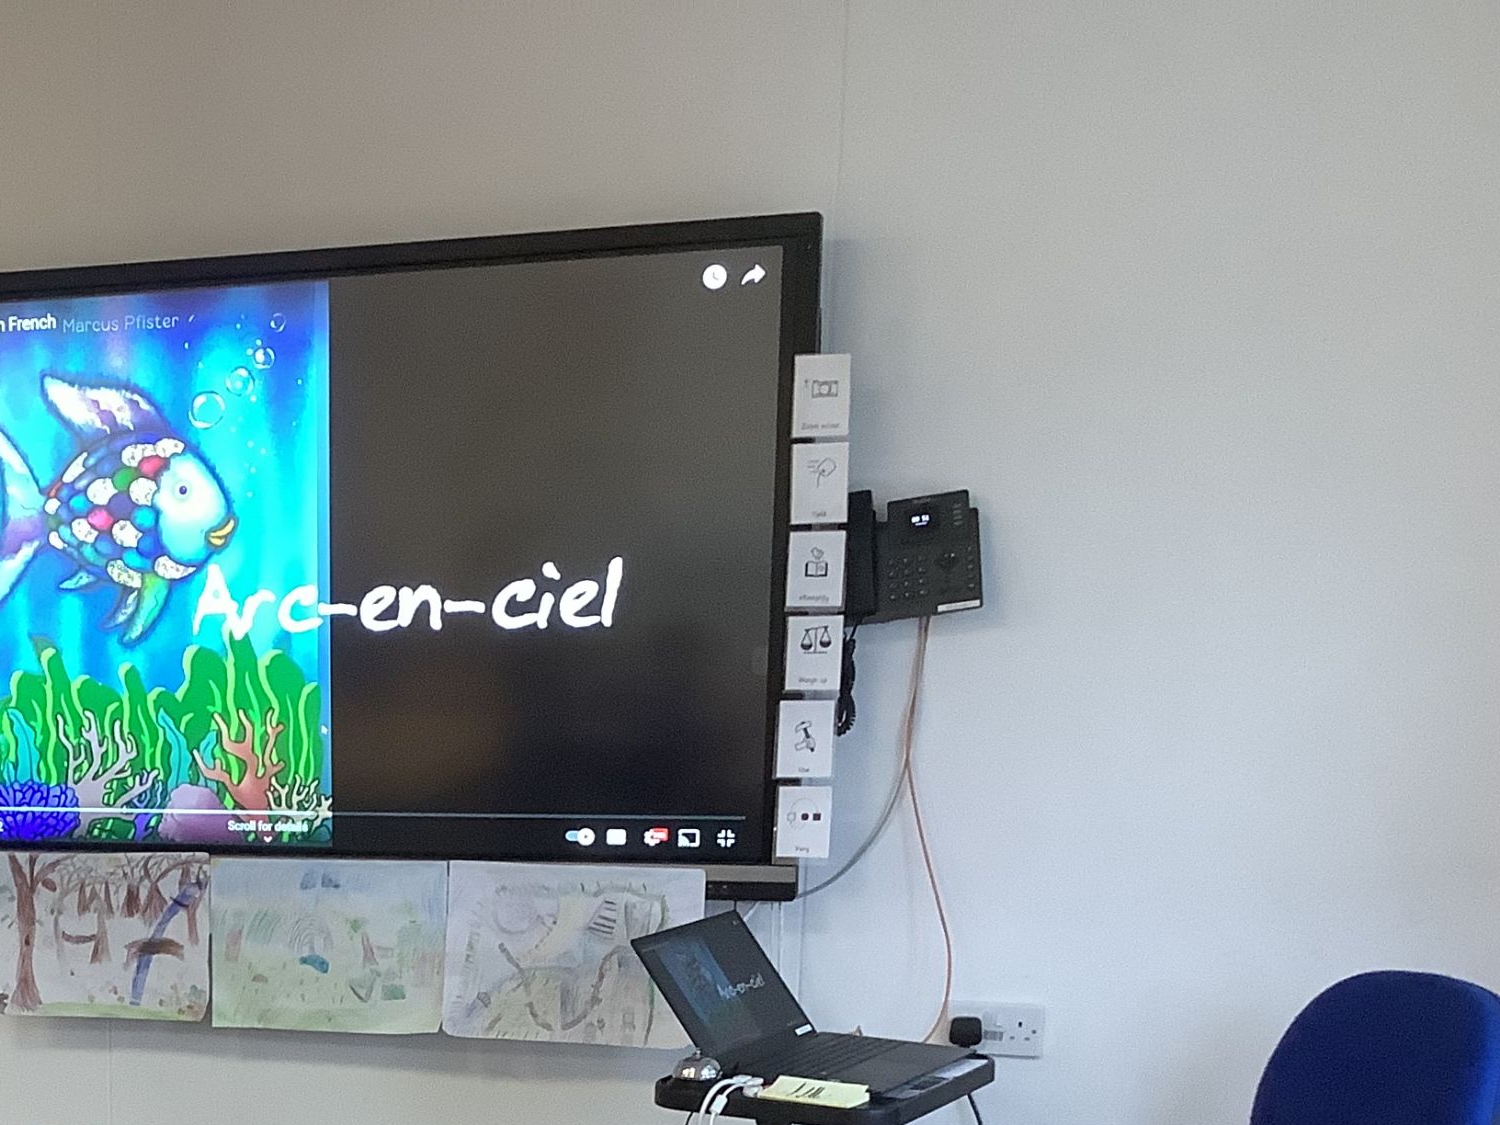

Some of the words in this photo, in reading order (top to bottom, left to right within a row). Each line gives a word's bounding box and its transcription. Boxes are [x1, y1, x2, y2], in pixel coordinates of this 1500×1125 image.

[8, 313, 56, 332] French
[62, 318, 119, 333] Marcus
[124, 314, 179, 331] Pfister
[192, 556, 624, 640] Arc-en-ciel
[227, 819, 256, 832] Scroll
[258, 820, 273, 832] for
[274, 820, 309, 832] details
